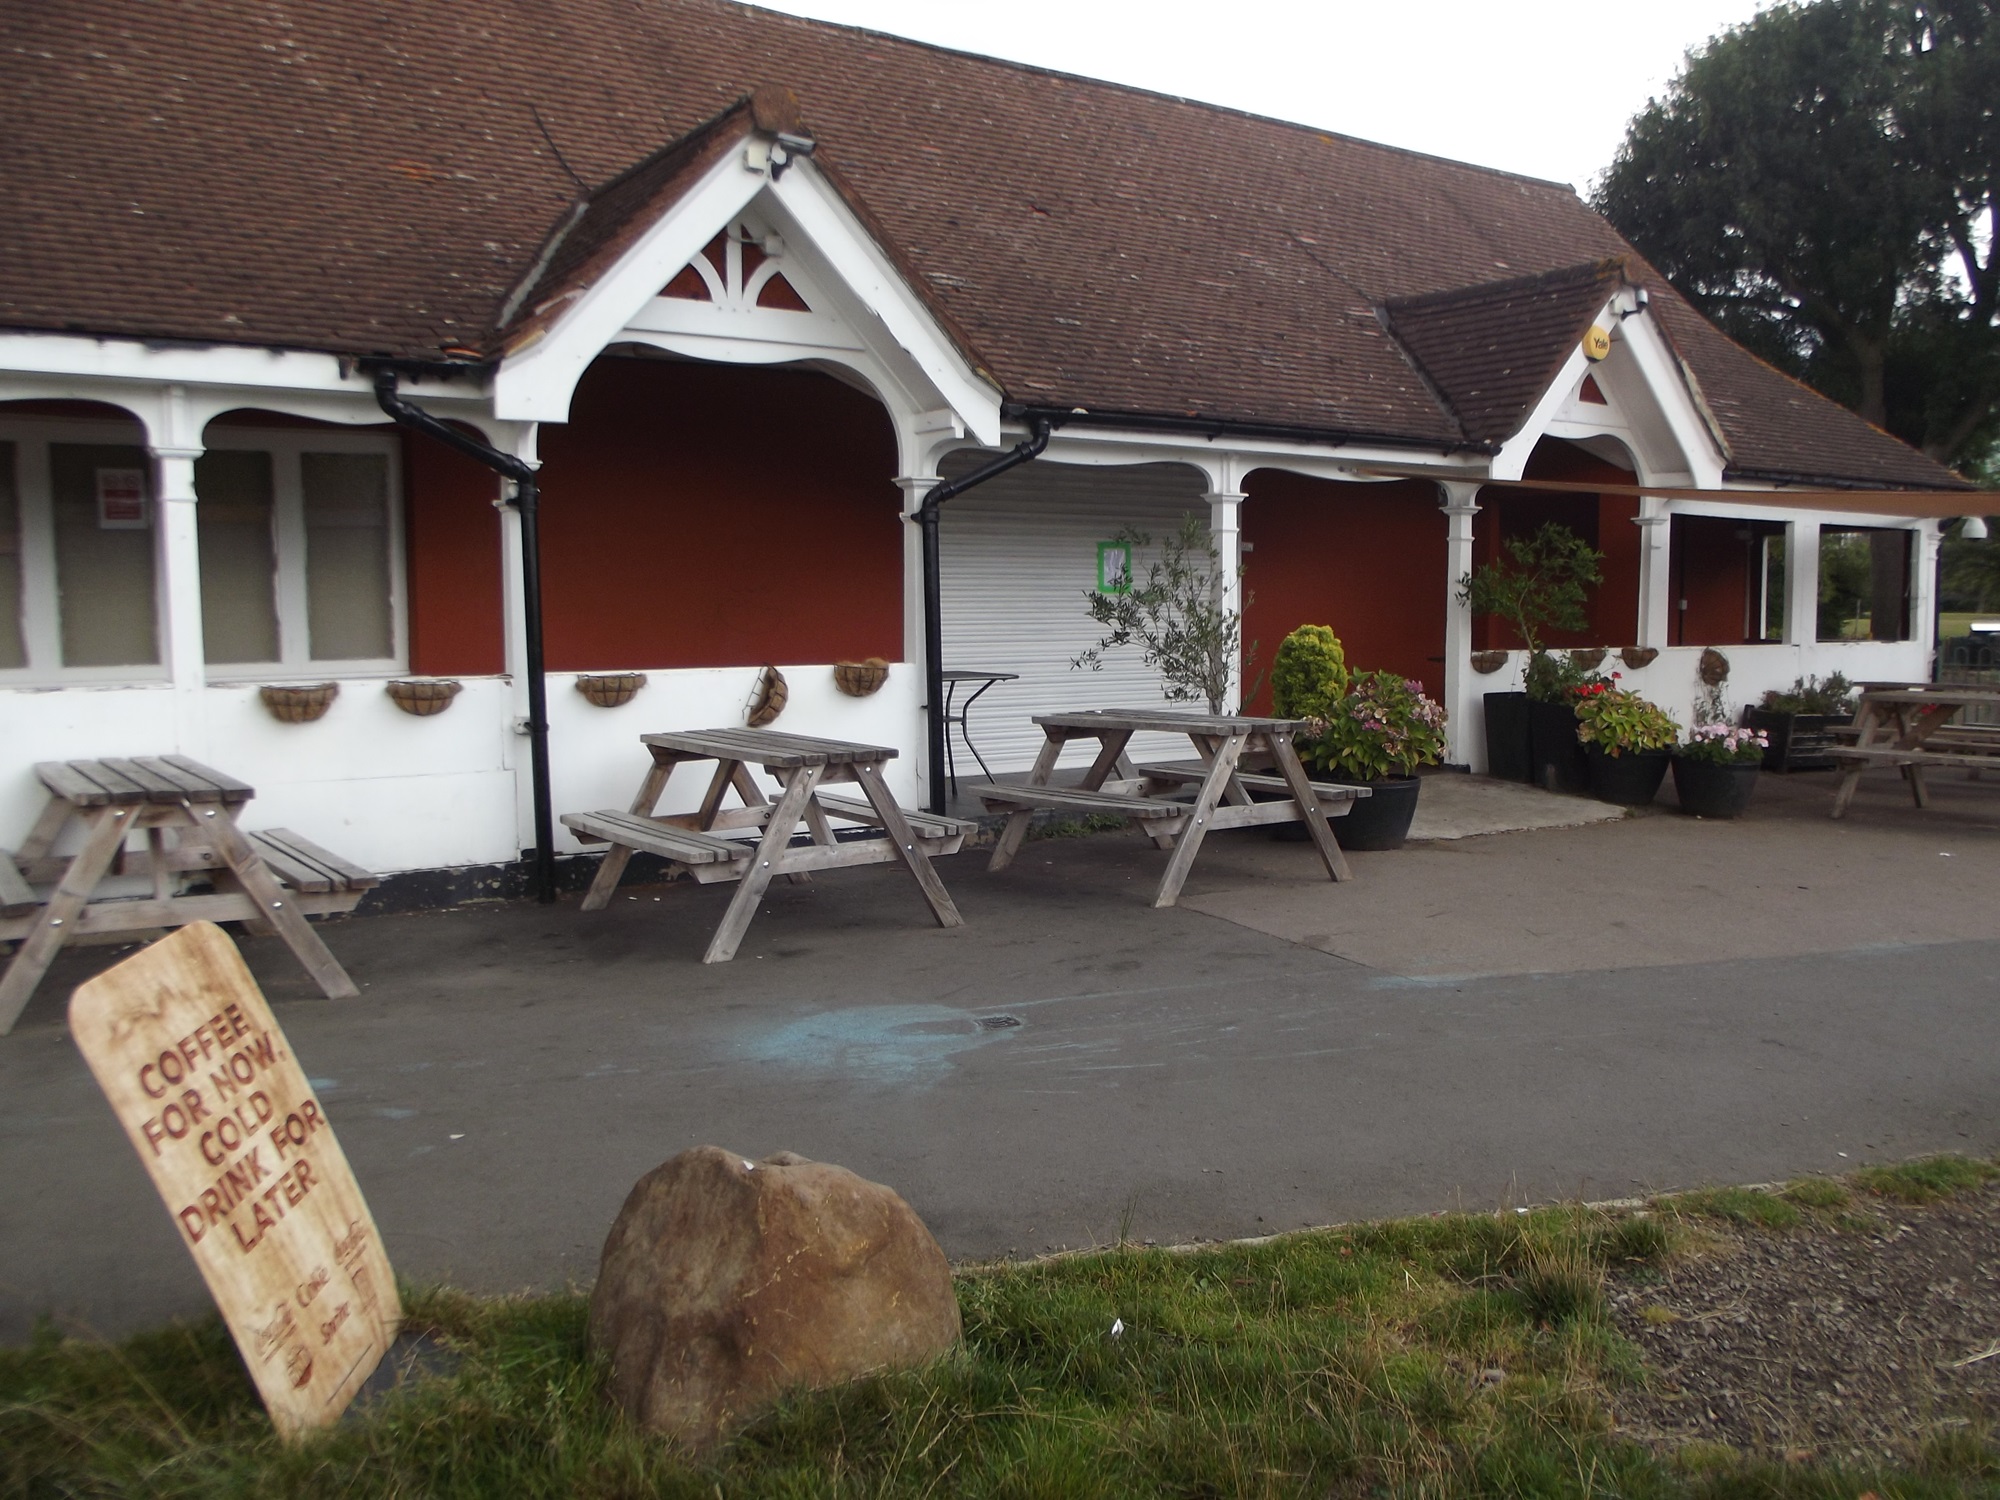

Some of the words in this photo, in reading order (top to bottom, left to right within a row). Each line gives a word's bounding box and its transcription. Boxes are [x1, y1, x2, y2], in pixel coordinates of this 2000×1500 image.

[1593, 337, 1609, 350] Yale
[139, 1003, 251, 1099] COFFEE
[141, 1088, 212, 1157] FOR
[200, 1090, 273, 1166] COLD
[178, 1146, 272, 1244] DRINK
[269, 1099, 325, 1161] FOR
[231, 1158, 319, 1255] LATER
